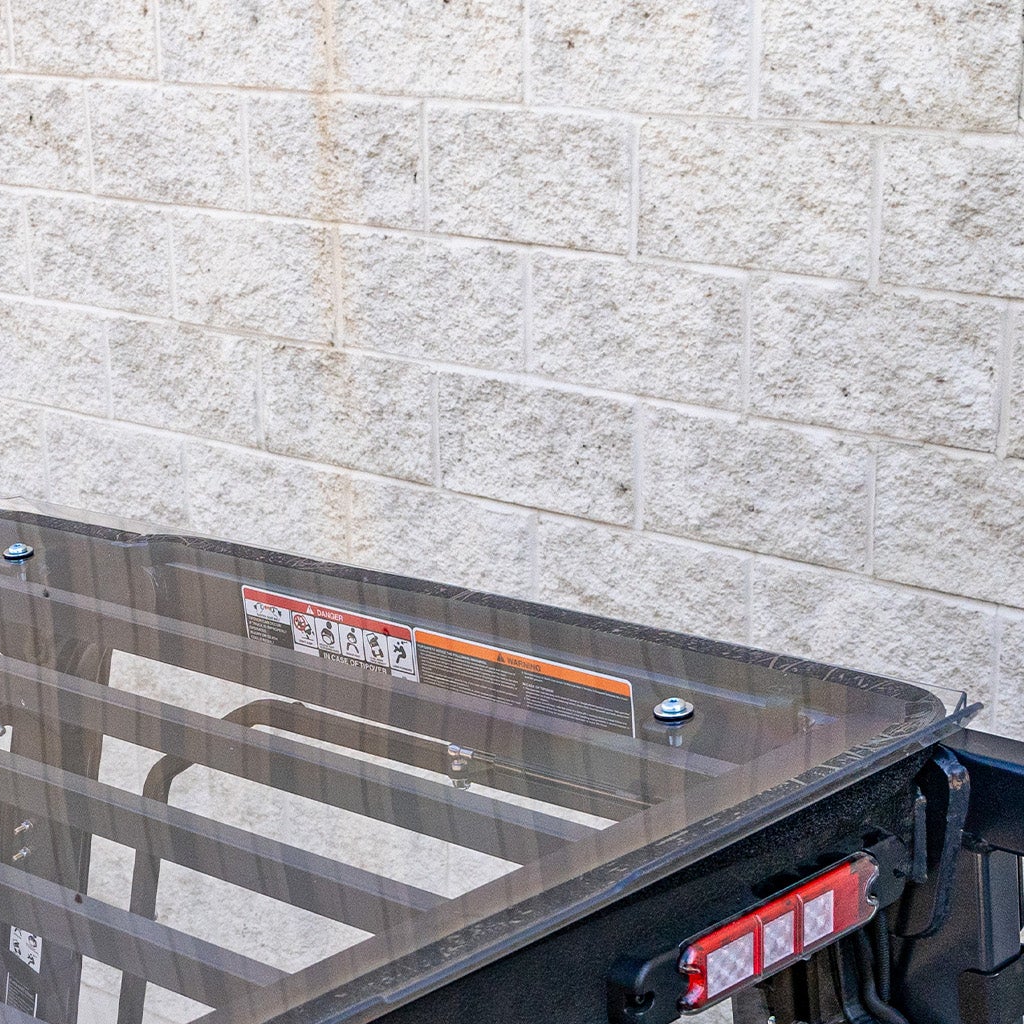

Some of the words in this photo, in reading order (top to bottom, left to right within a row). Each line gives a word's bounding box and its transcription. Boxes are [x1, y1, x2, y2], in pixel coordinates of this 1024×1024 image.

[316, 609, 344, 622] DANGER
[323, 652, 331, 660] IN
[331, 654, 349, 665] CASE
[359, 661, 387, 674] TIPOVER
[507, 656, 542, 673] WARNING
